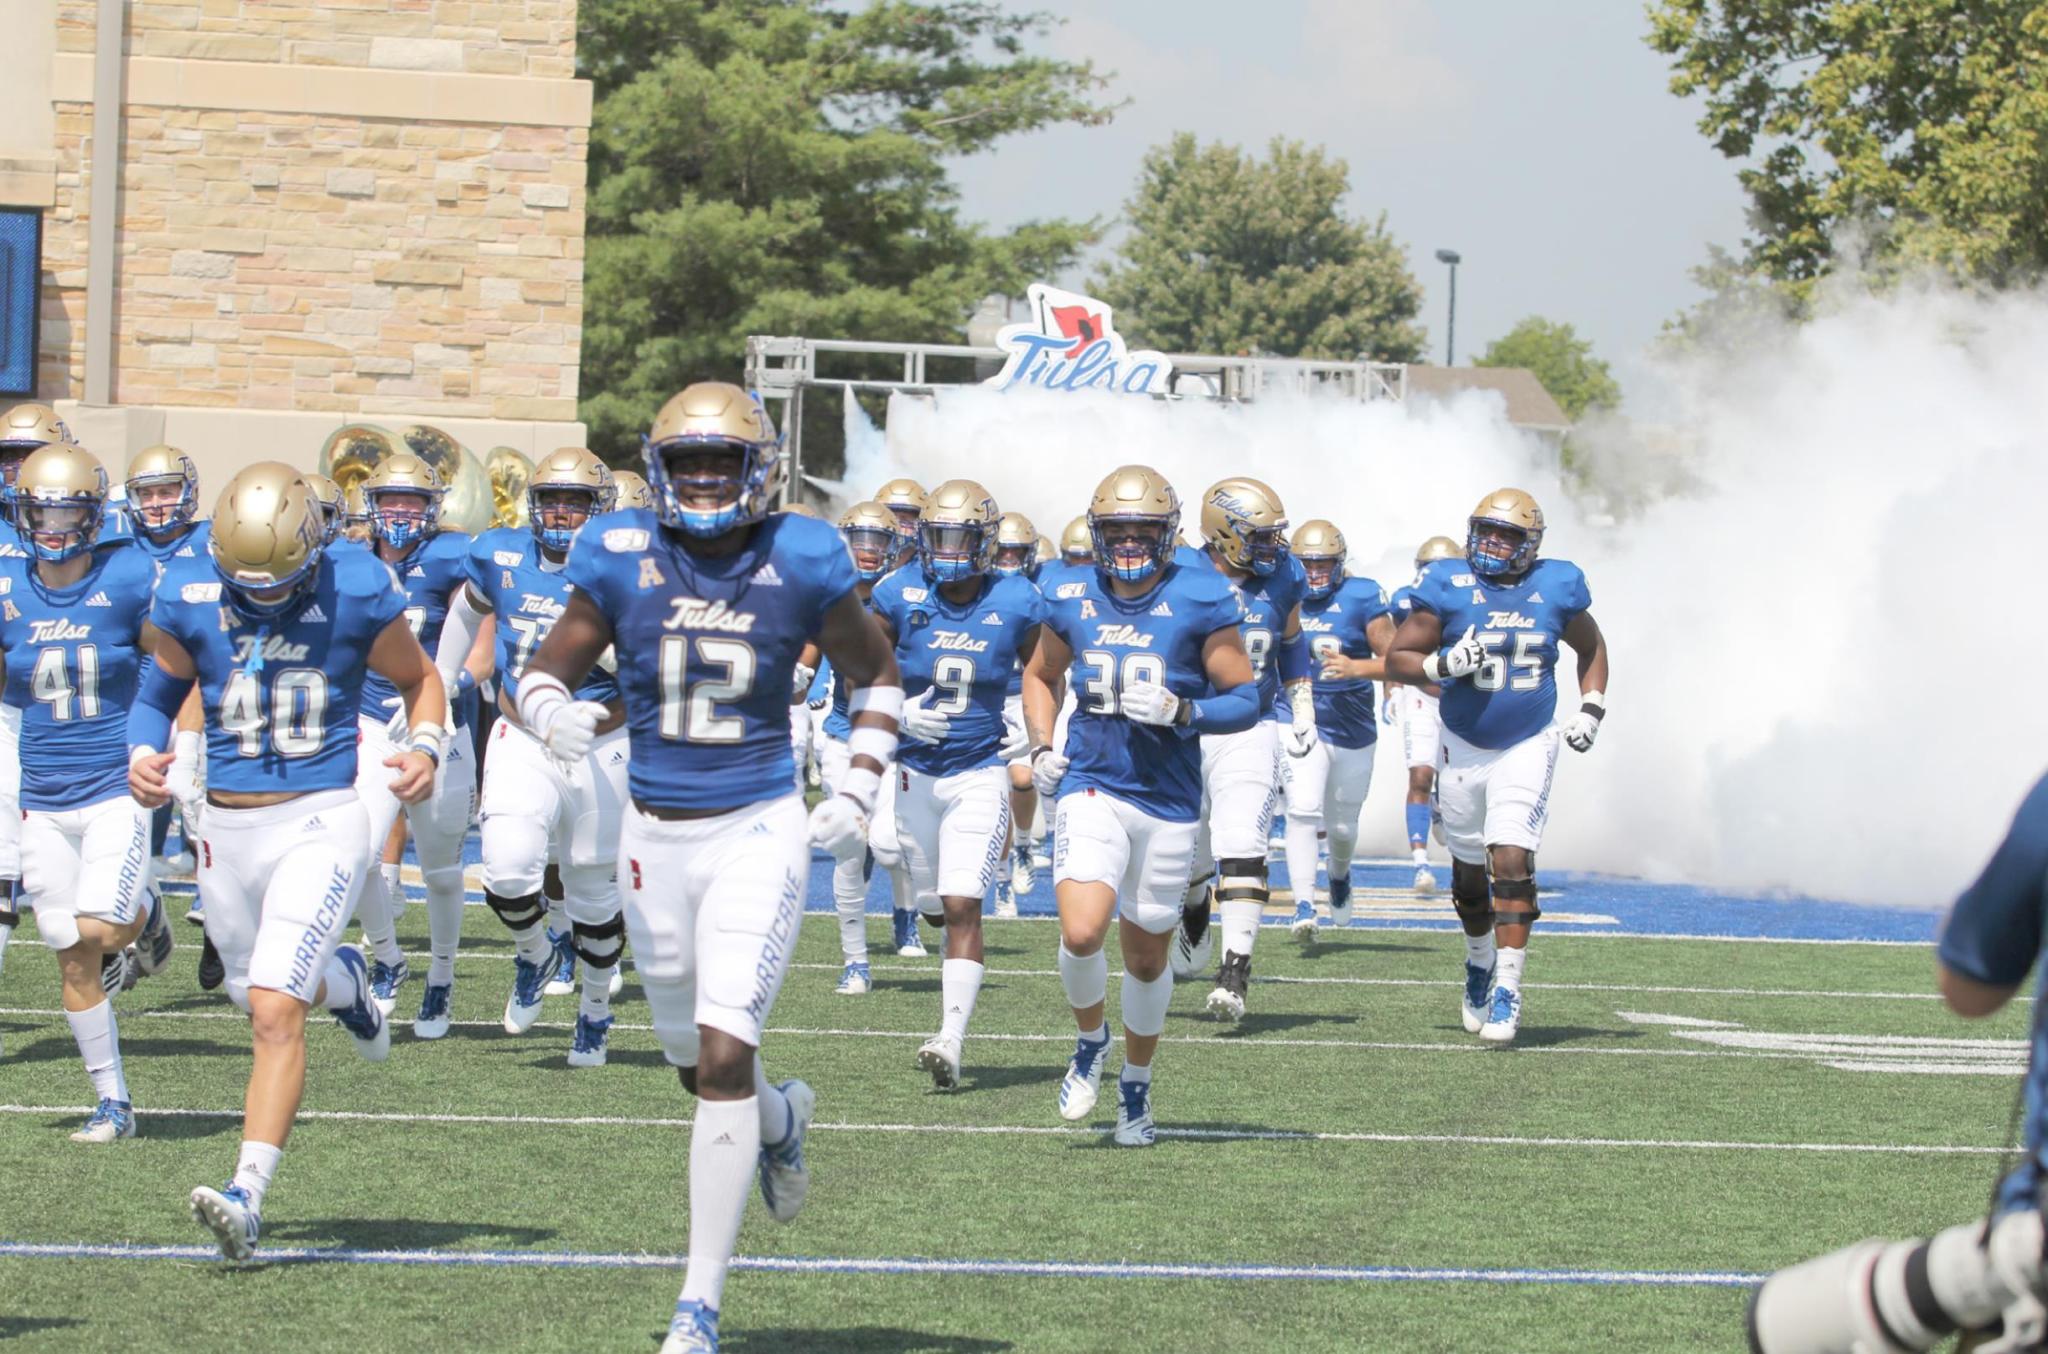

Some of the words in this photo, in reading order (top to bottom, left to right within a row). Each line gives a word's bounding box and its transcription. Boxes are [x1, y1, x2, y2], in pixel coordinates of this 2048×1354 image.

[1000, 334, 1158, 393] Tulsa
[1208, 488, 1254, 520] Tulsa
[27, 617, 92, 644] Tulsa
[662, 596, 756, 633] Tulsa
[927, 630, 989, 653] Tulsa
[1092, 624, 1154, 649] Tulsa
[1484, 610, 1536, 630] Tulsa
[230, 634, 311, 663] Tlsa
[1473, 631, 1547, 691] 65
[31, 643, 100, 722] 41
[658, 634, 757, 744] 12
[932, 654, 976, 717] 9
[219, 667, 329, 759] 40
[112, 813, 148, 922] HURRICANE
[978, 790, 1010, 888] HURRICANE
[1056, 811, 1070, 868] GOLDEN
[286, 863, 351, 996] HURRICANE
[745, 865, 802, 1024] HURRICANE
